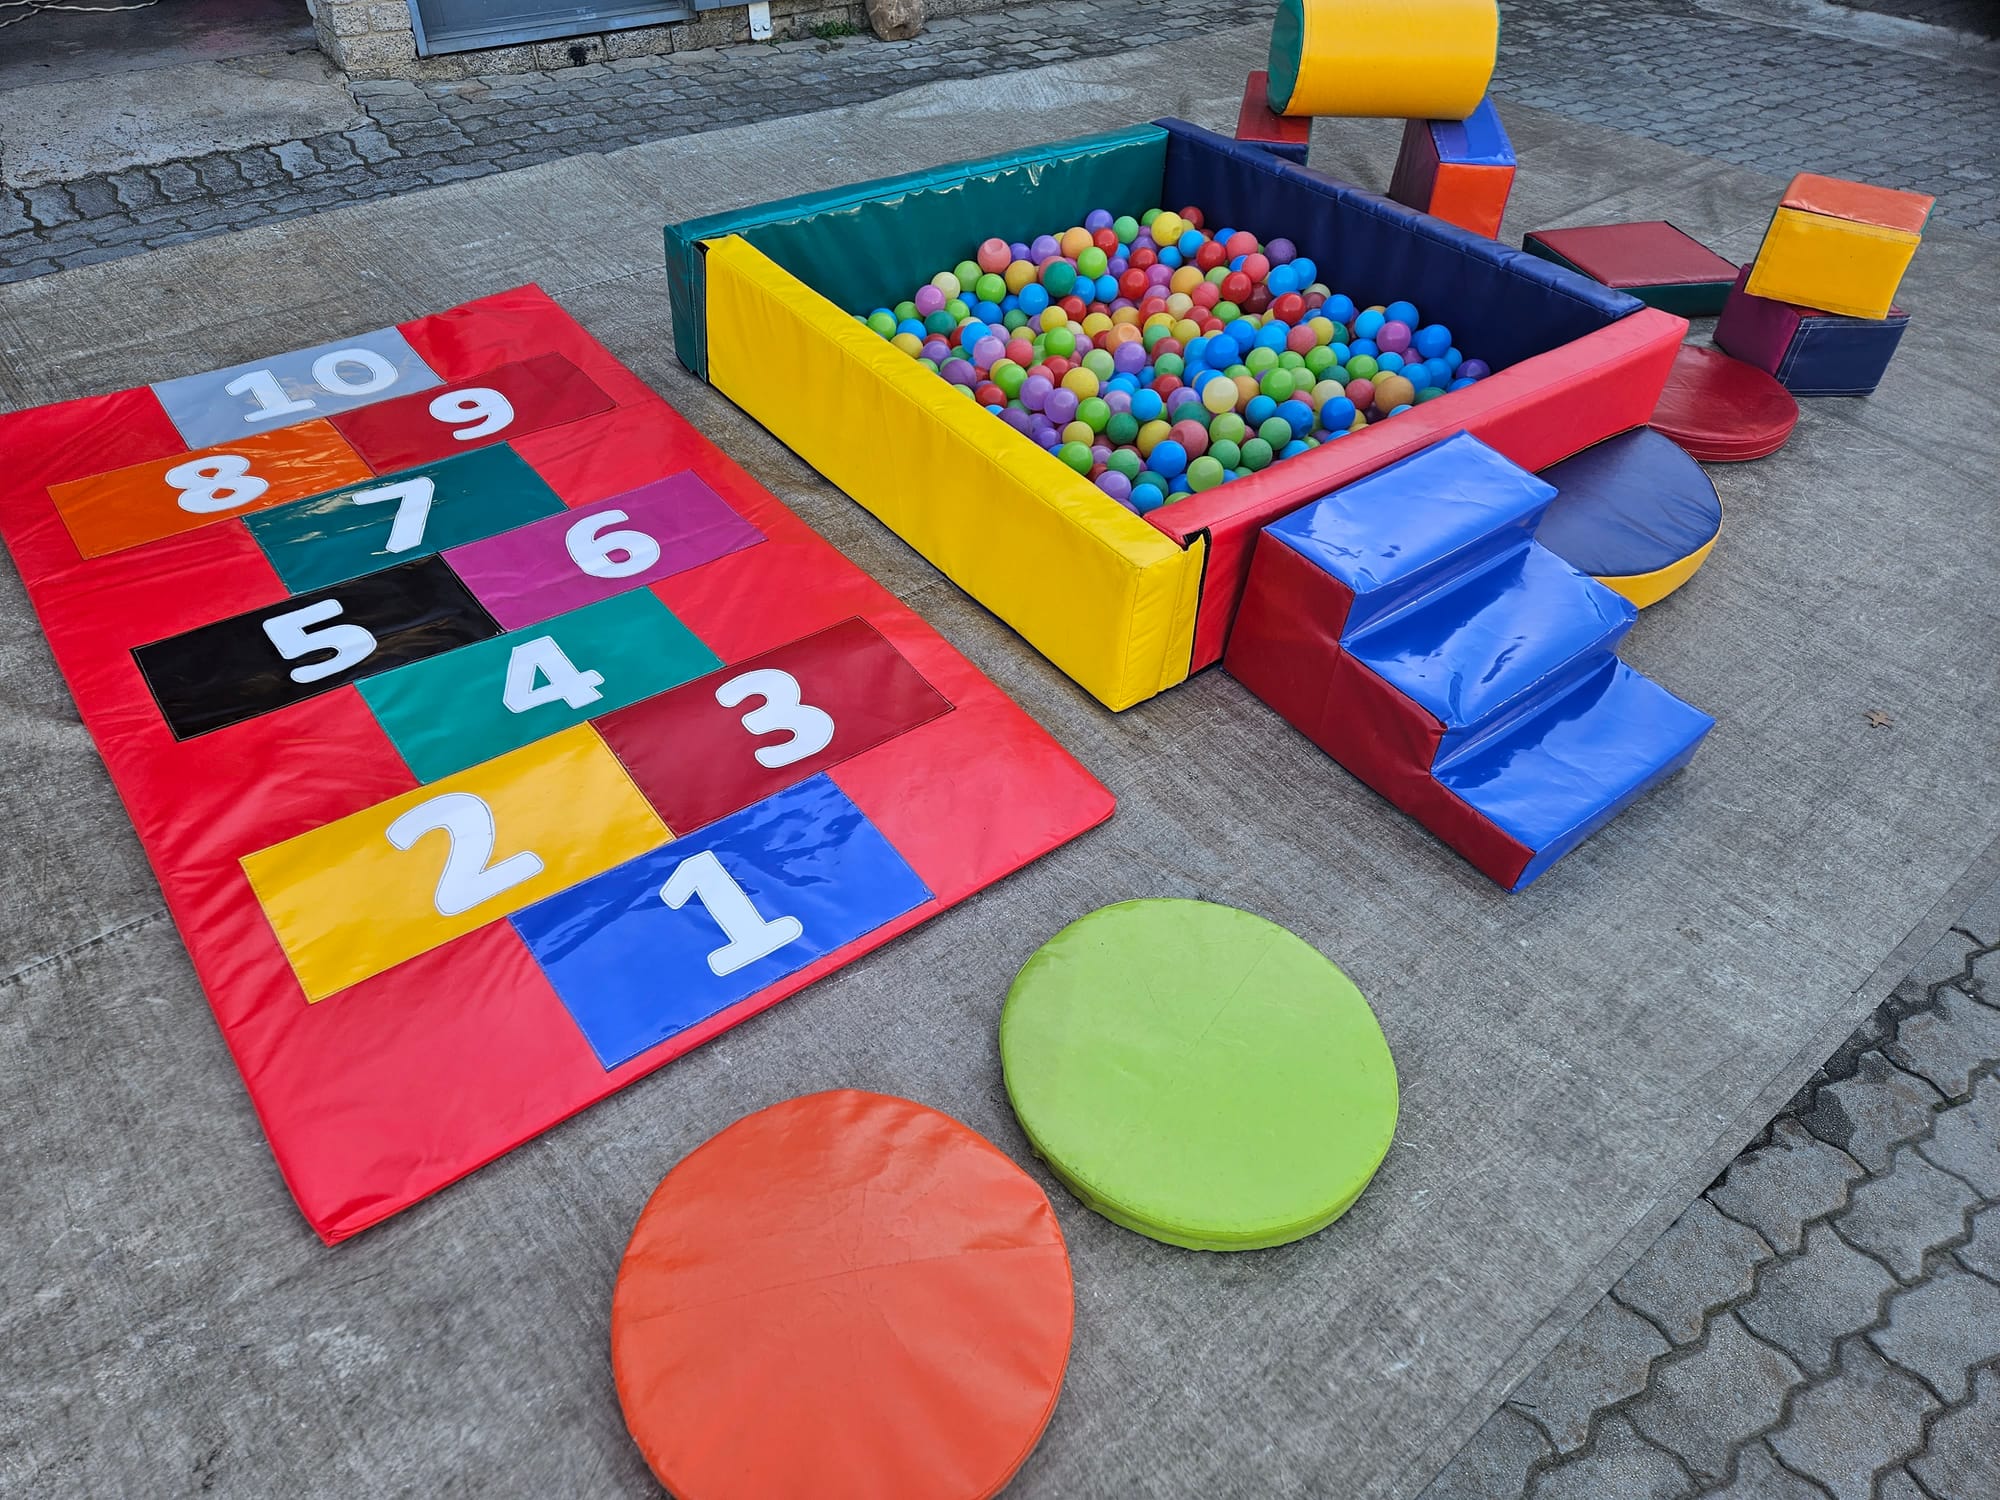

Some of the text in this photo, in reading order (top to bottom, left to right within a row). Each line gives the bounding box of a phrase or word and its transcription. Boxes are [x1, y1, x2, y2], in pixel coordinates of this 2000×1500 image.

[225, 348, 399, 422] 10
[429, 388, 514, 441] 9
[165, 455, 269, 514] 8
[352, 476, 434, 553] 7
[566, 509, 660, 578] 6
[263, 599, 377, 684] 5
[502, 636, 604, 713] 4
[715, 669, 835, 768] 3
[386, 793, 544, 917] 2
[659, 850, 803, 976] 1
